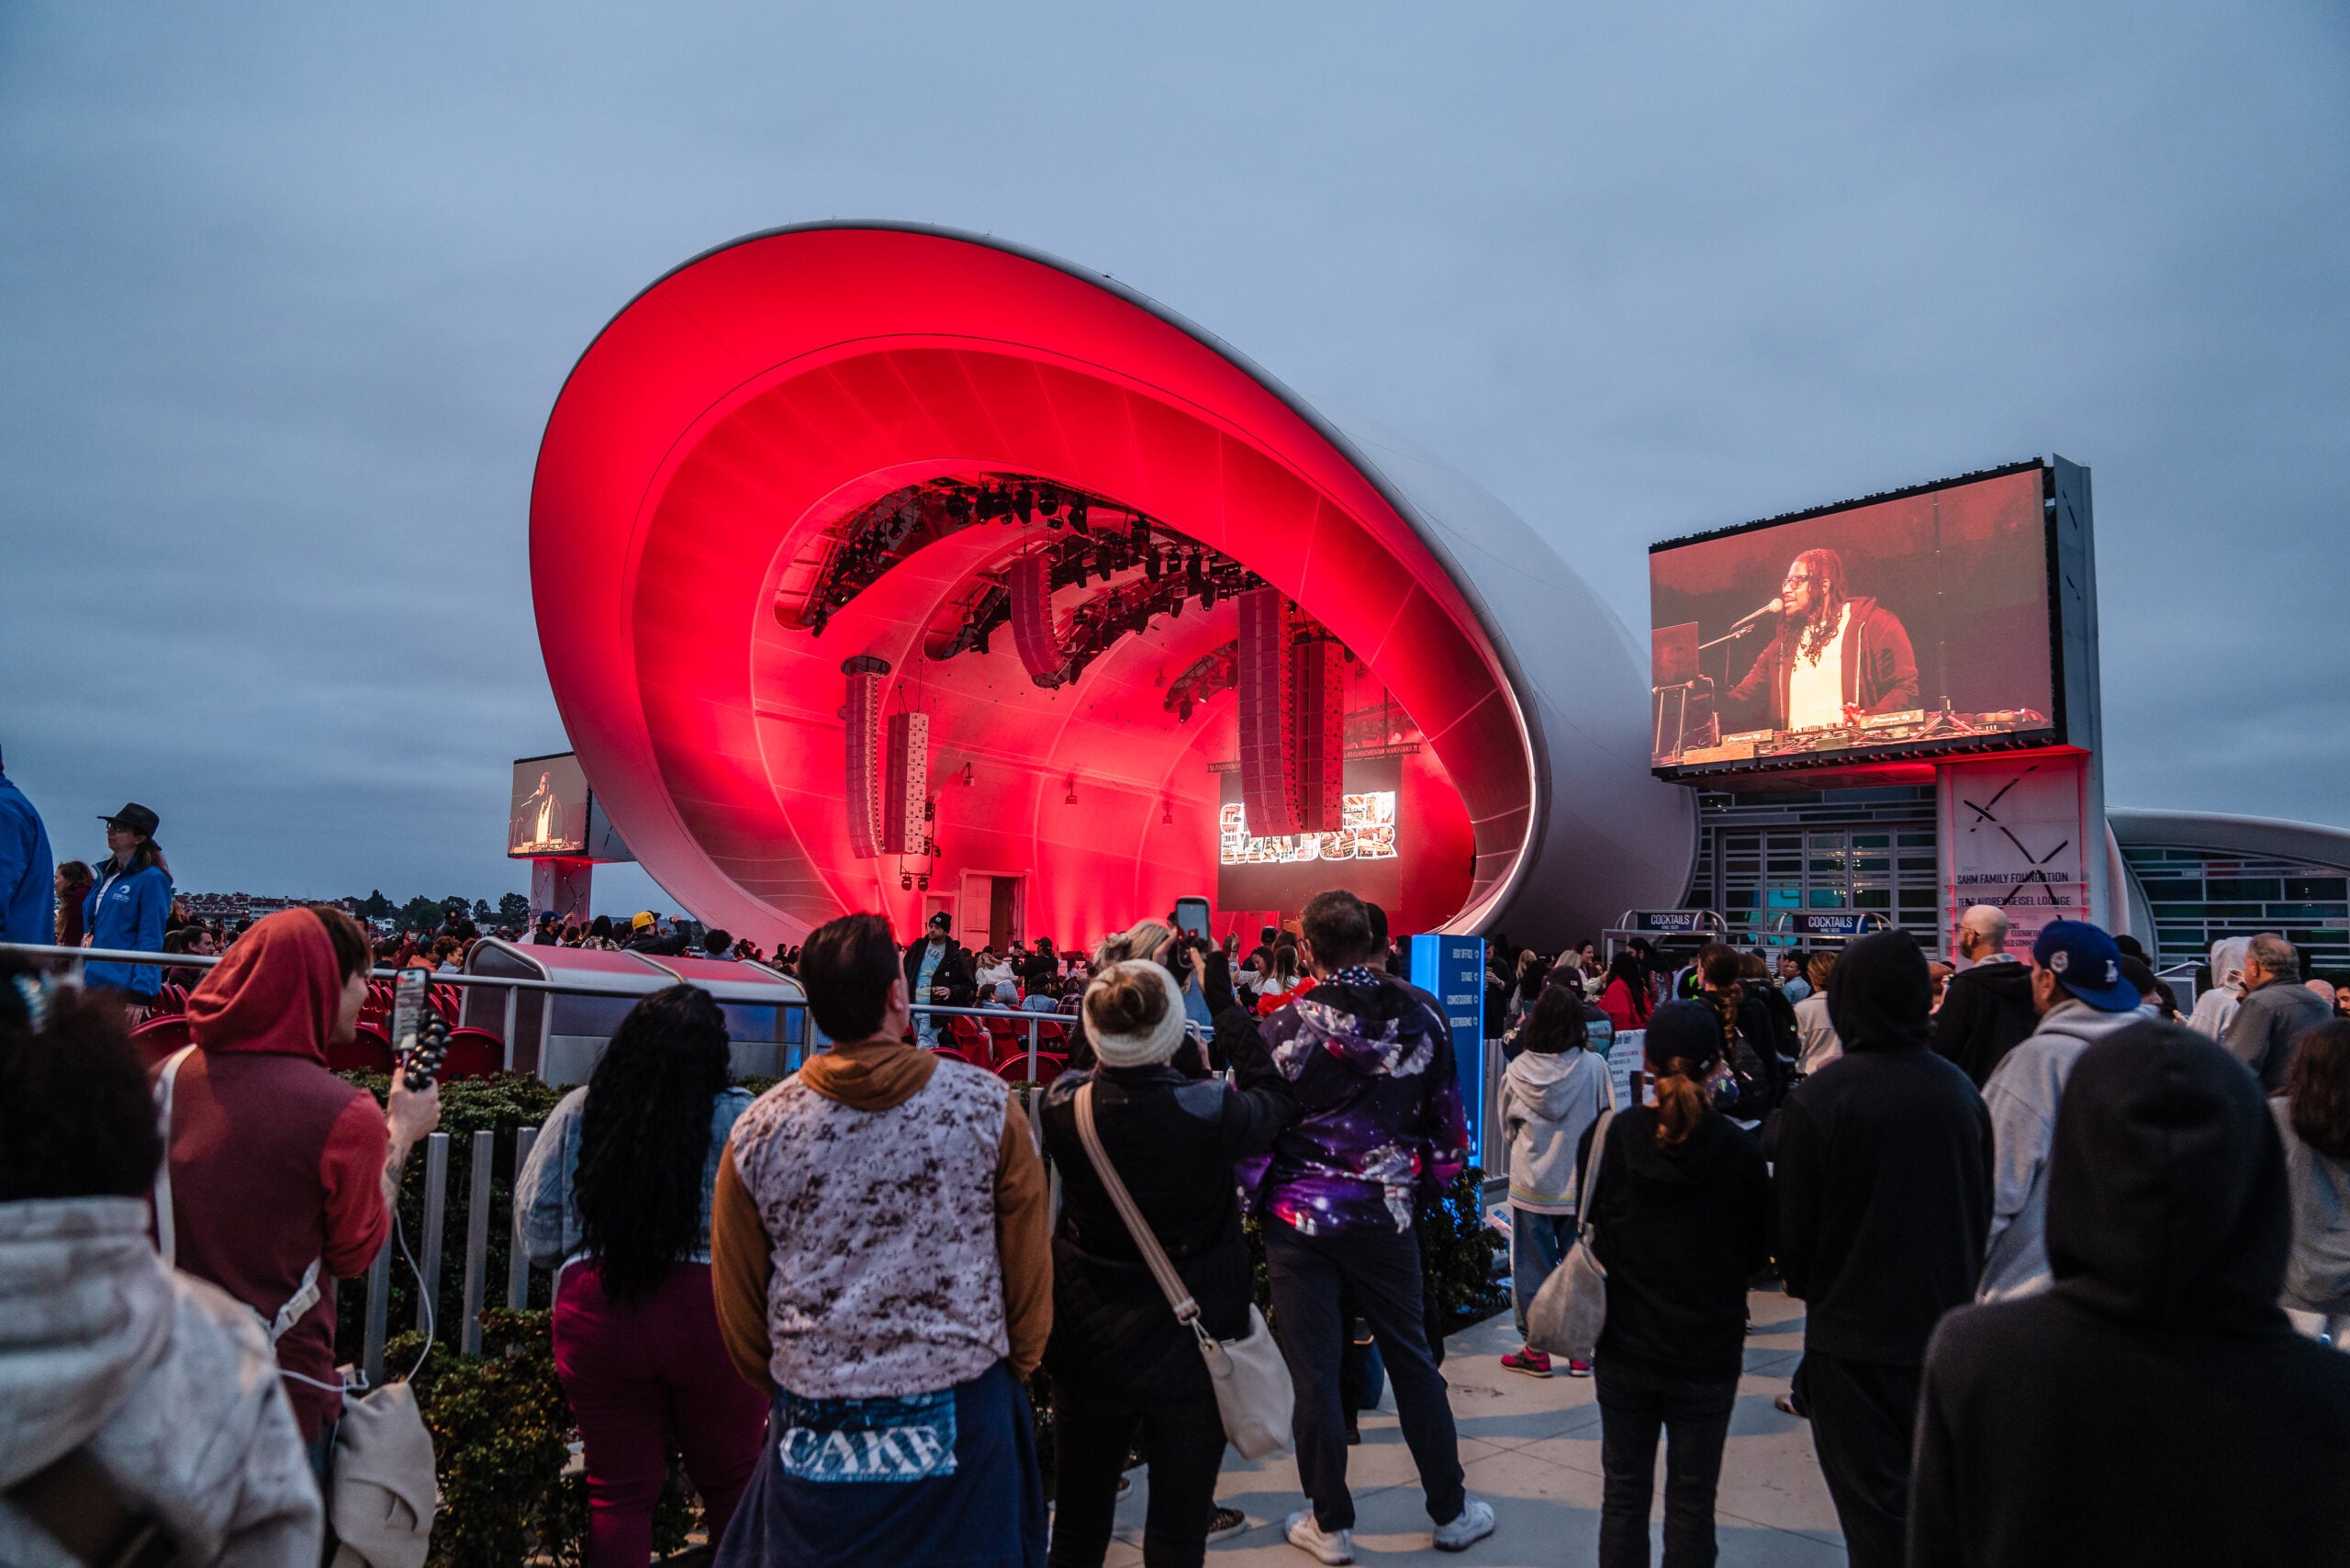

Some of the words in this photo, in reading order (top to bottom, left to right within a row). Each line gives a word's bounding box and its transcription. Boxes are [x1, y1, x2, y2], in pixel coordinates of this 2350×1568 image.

[1221, 825, 1398, 865] MAJOR
[1957, 874, 1978, 884] SAHM
[1980, 873, 2009, 883] FAMILY
[2009, 897, 2035, 906] GEISEL
[1651, 914, 1690, 924] COCKTAILS
[1808, 916, 1852, 927] COCKTAILS
